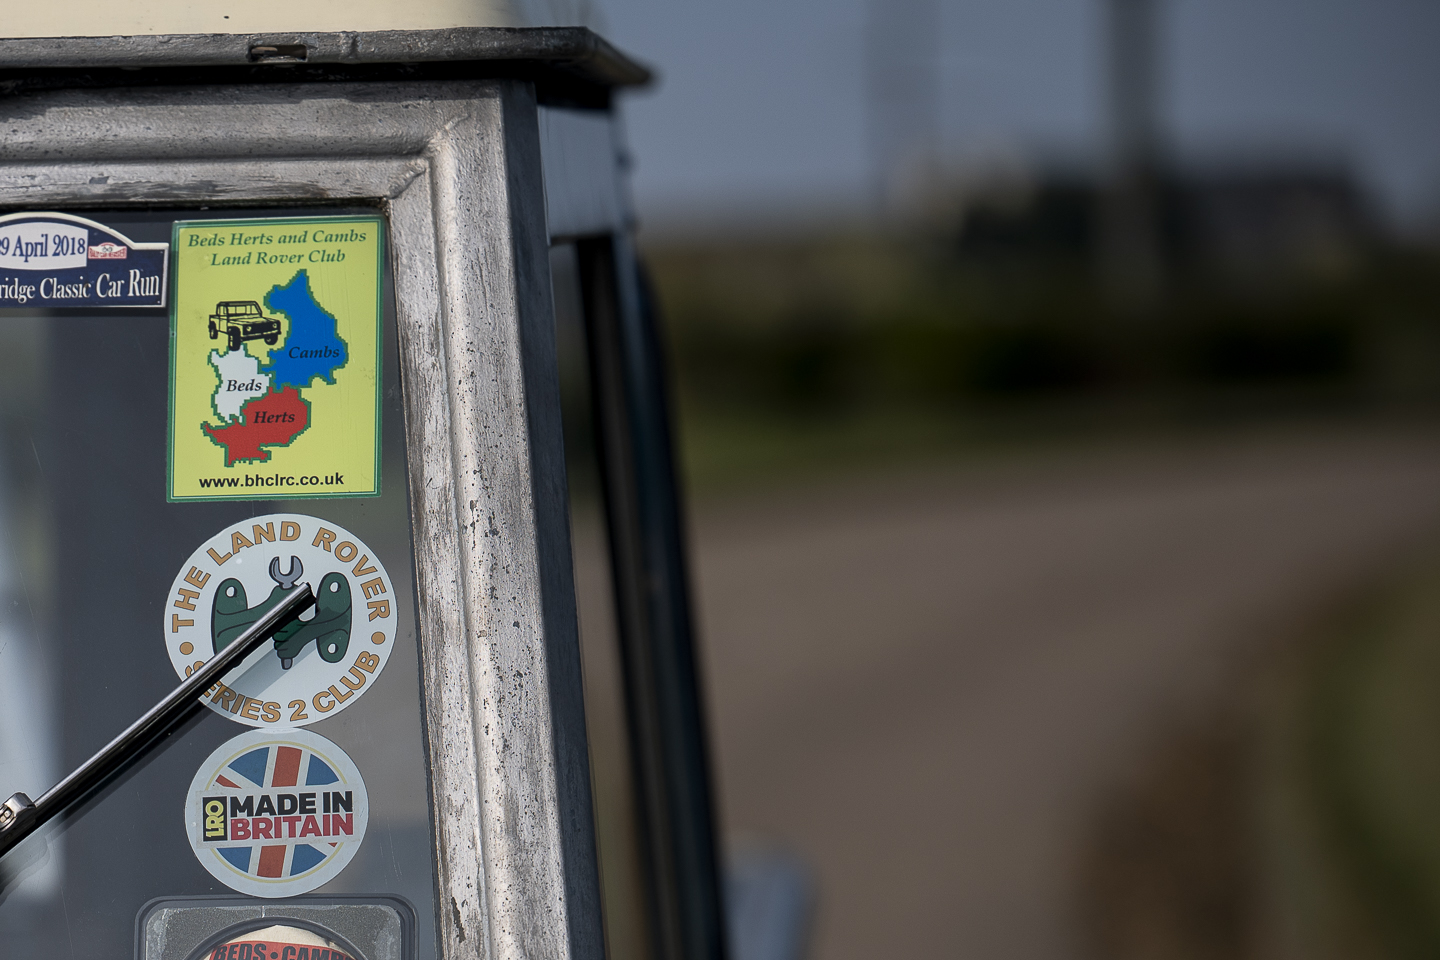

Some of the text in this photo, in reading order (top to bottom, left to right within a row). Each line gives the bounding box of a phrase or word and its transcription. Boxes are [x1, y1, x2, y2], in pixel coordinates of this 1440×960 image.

[12, 233, 48, 262] April
[52, 234, 85, 257] 2018
[187, 228, 367, 247] Beds Herts and Cambs
[210, 249, 346, 266] Land Rover Club
[39, 275, 91, 299] Classic
[96, 272, 125, 298] Car
[127, 268, 160, 297] Run
[288, 346, 340, 359] Cambs
[226, 379, 262, 392] Beds
[253, 410, 295, 424] Herts
[199, 472, 345, 488] www.bhclrc.co.uk
[171, 521, 391, 633] THE LAND ROVER
[288, 700, 308, 722] 2
[312, 651, 380, 714] CLUB
[230, 791, 353, 818] MADE IN
[205, 800, 225, 838] LRO
[230, 813, 354, 841] BRITAIN
